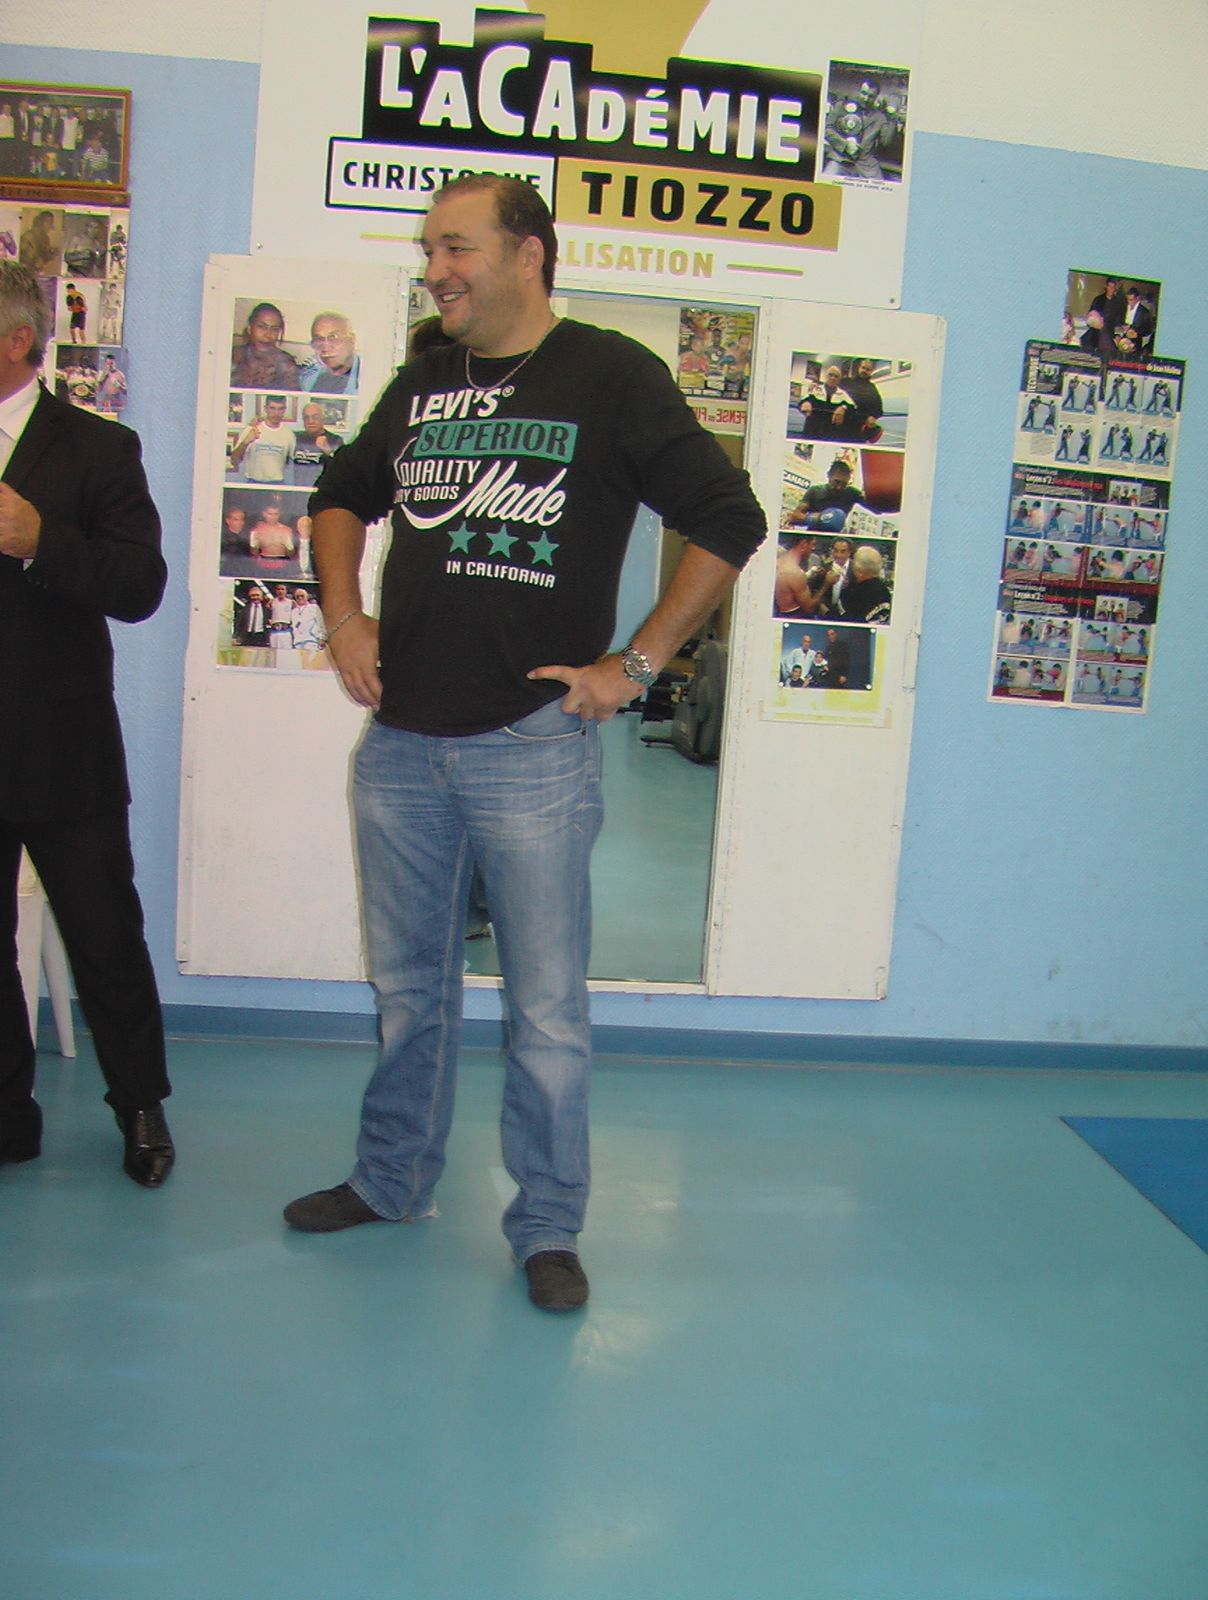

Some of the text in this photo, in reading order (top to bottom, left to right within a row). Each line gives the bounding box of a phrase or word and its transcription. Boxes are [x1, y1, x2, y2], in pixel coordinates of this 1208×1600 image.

[343, 161, 815, 236] CHRIST TIOZZO
[556, 241, 714, 278] LISATION
[420, 422, 570, 458] SUPERIOR
[400, 459, 481, 487] QUALITY
[413, 485, 460, 502] GOODS
[462, 460, 568, 527] Made
[446, 560, 556, 589] IN CALIFORNIA
